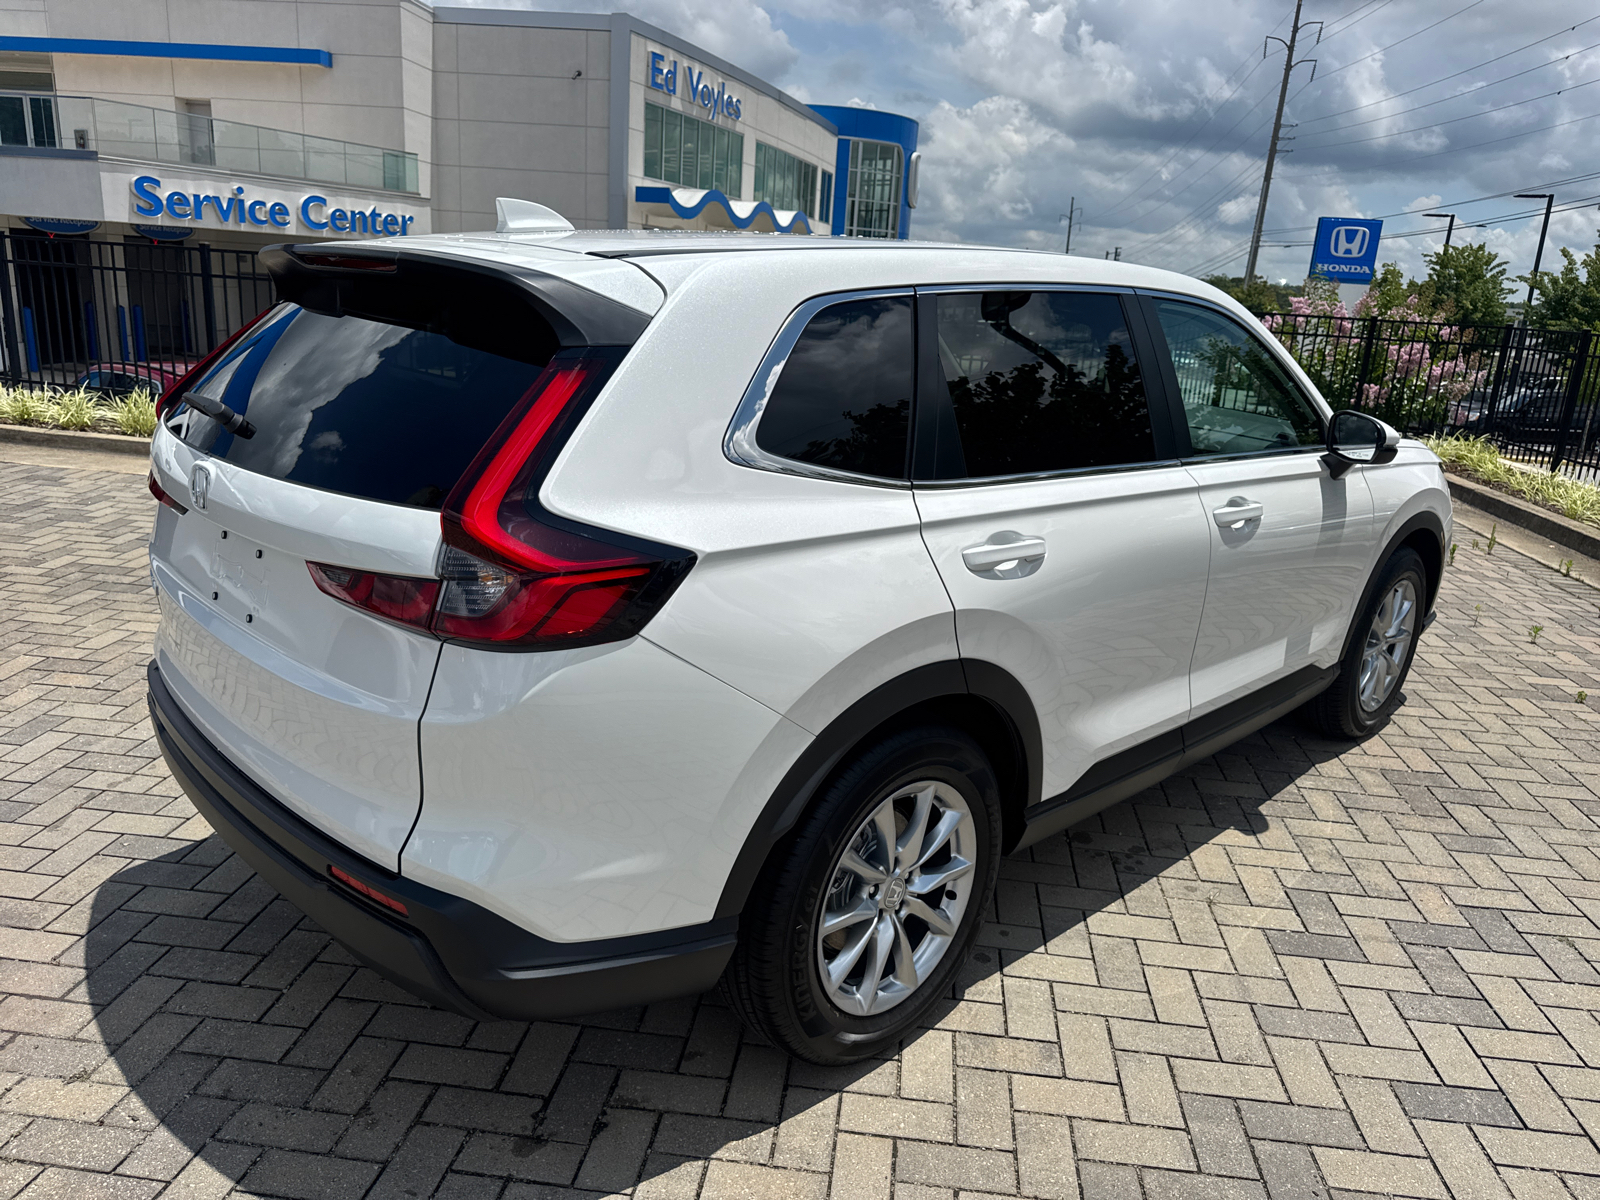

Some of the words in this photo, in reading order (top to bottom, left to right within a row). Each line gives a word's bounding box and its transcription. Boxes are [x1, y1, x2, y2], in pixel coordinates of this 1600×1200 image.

[651, 51, 677, 95] Ed
[688, 66, 741, 120] Voyles
[134, 176, 290, 227] Service
[300, 195, 414, 236] Center
[1317, 263, 1371, 274] HONDA
